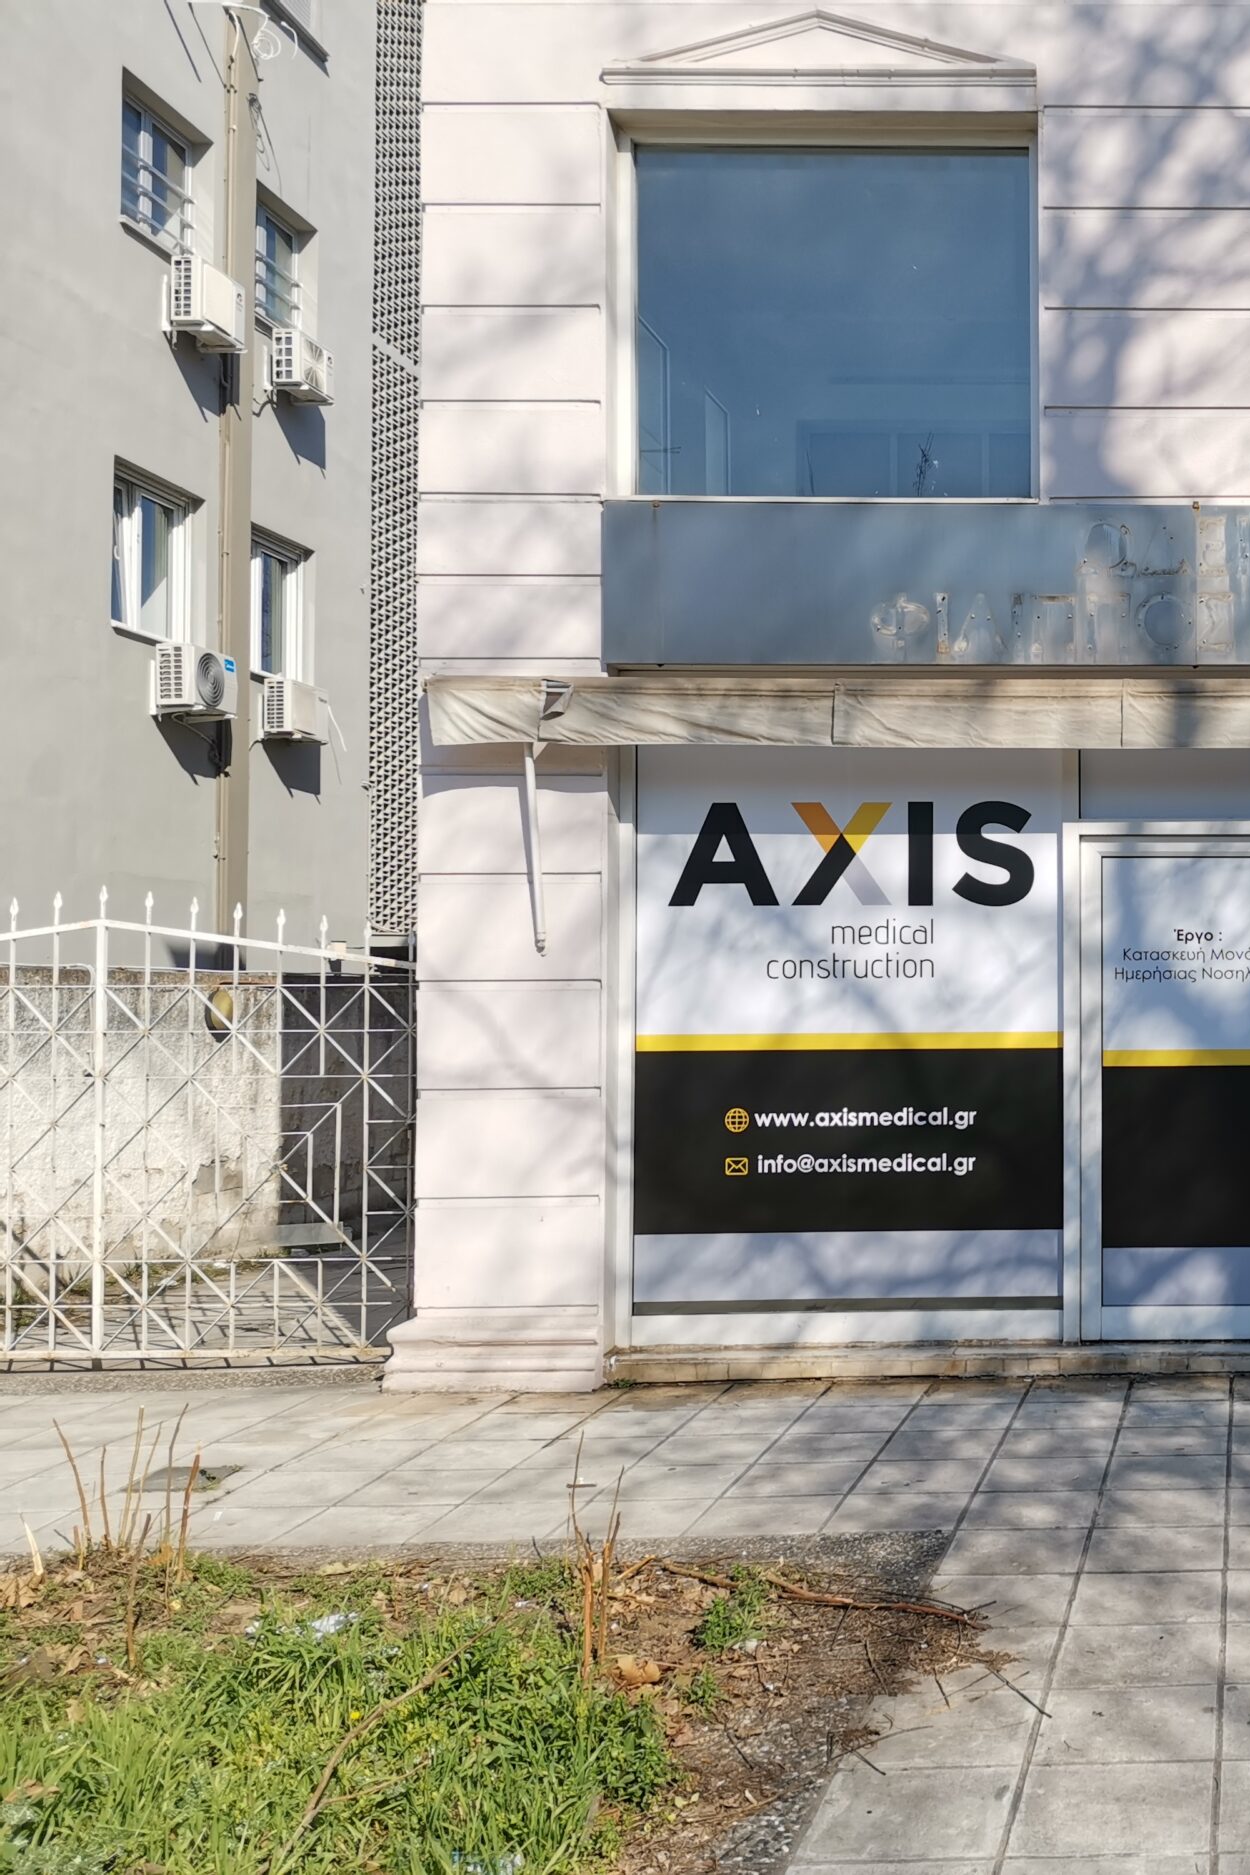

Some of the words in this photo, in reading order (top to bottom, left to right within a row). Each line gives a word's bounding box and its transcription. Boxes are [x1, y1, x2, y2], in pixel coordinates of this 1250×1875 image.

[668, 801, 1035, 906] AXIS
[831, 918, 934, 945] medical
[766, 952, 935, 979] construction
[1123, 948, 1206, 963] Κατασκευή
[1114, 967, 1197, 983] Ημερήσιας
[754, 1107, 977, 1130] www.axismedical.gr
[757, 1153, 976, 1176] info@axismedical.gr
